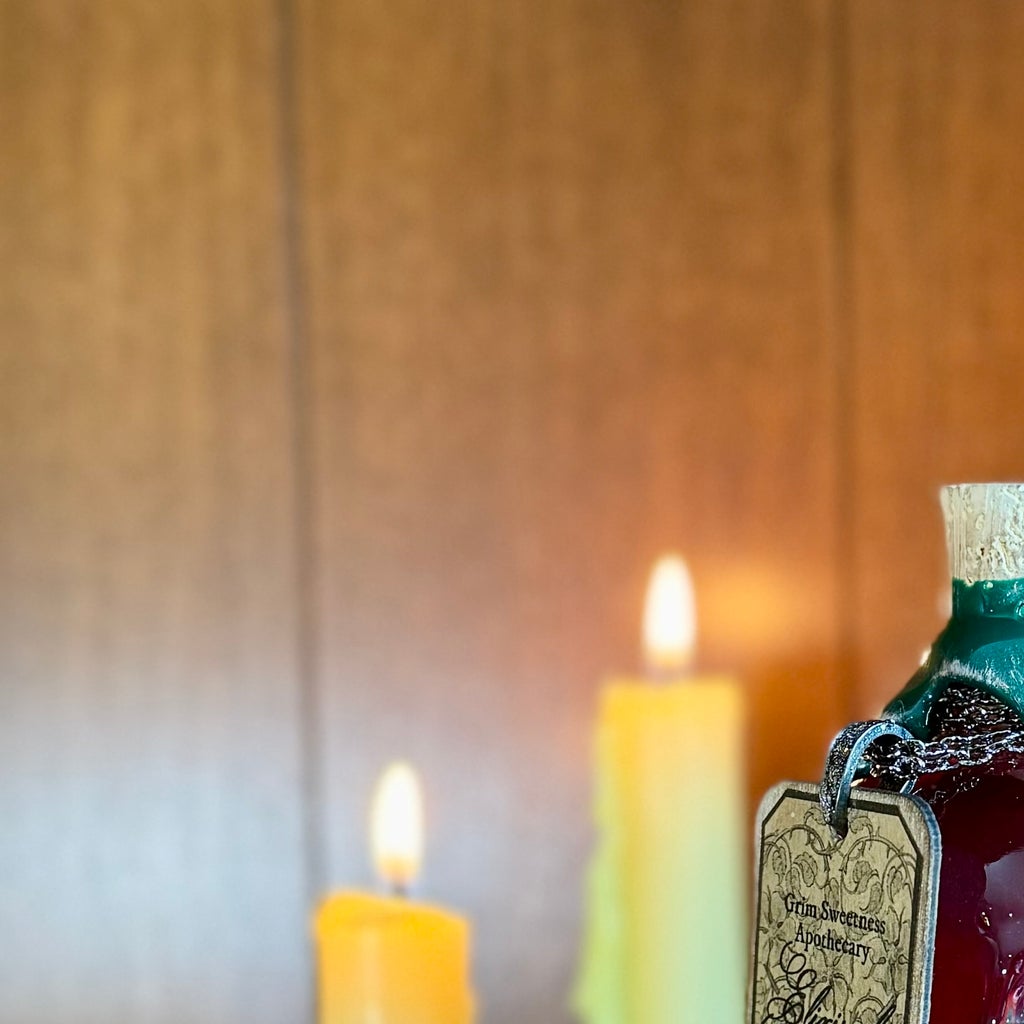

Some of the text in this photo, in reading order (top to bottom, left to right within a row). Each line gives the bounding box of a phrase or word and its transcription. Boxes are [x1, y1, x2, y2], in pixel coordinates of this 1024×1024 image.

[784, 893, 886, 935] Grim Sweetness
[795, 922, 871, 965] Apothecary
